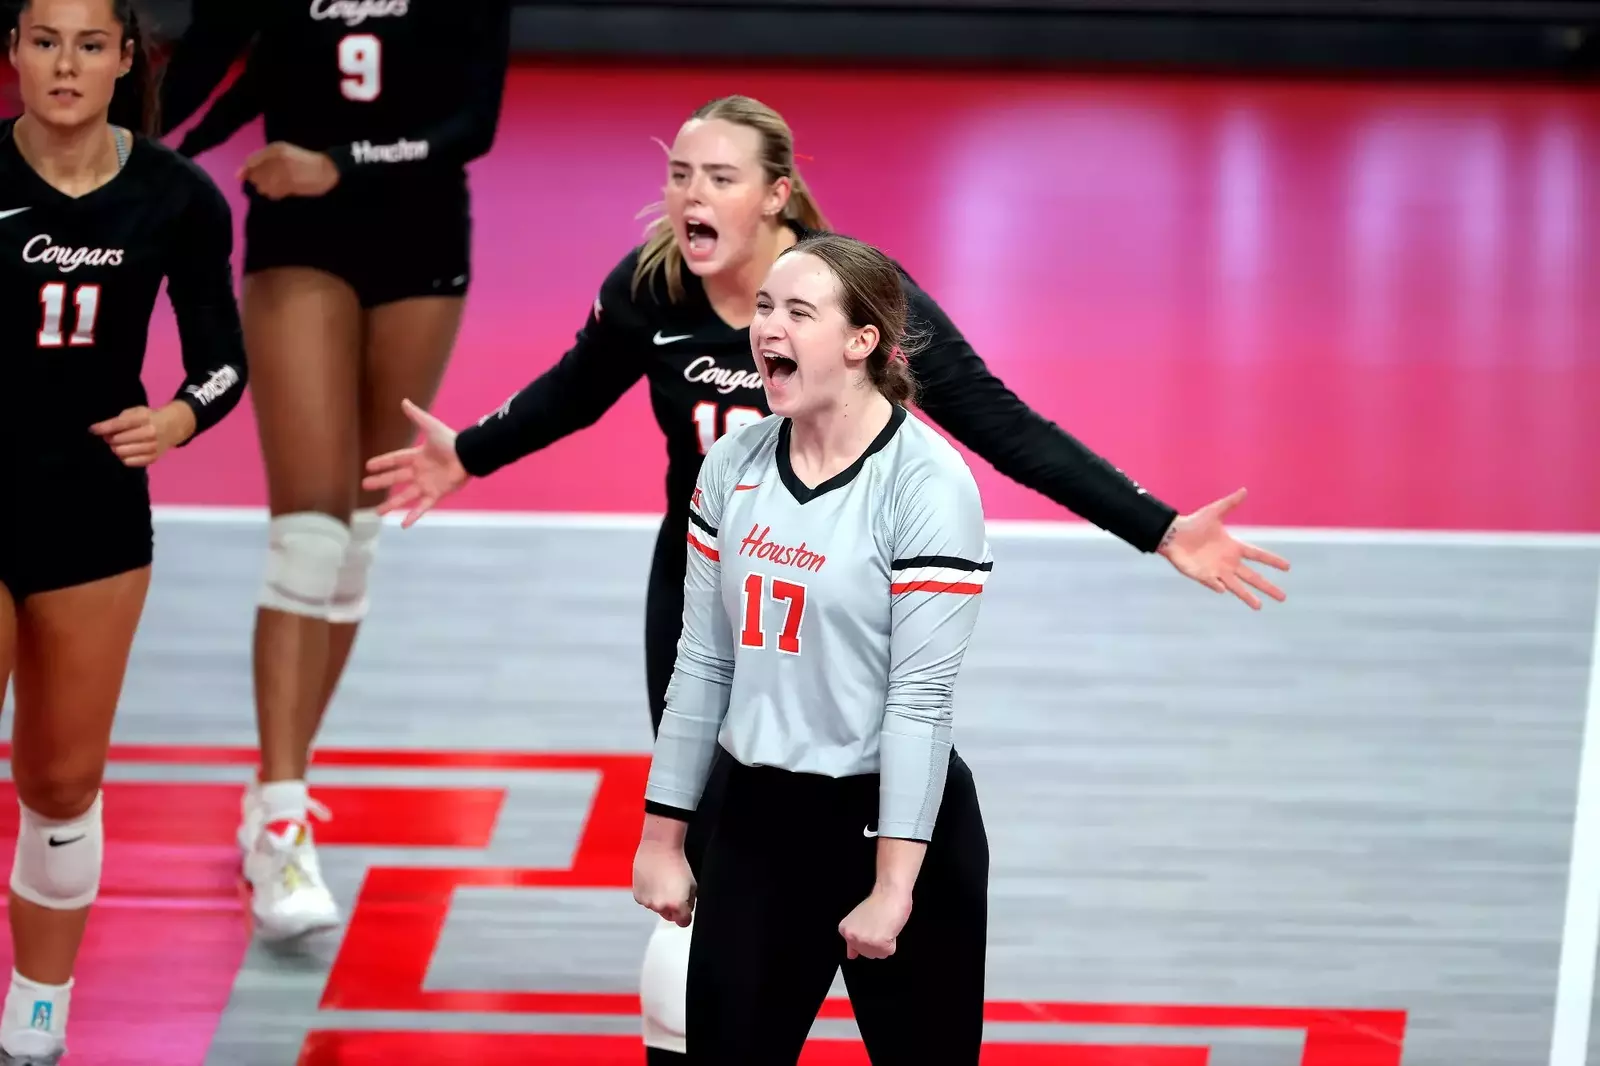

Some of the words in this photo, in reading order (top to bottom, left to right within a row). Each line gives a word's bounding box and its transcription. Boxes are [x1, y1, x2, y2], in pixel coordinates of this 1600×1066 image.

[338, 33, 382, 102] 9
[22, 233, 125, 273] Cougars
[37, 280, 101, 348] 11
[738, 523, 827, 573] Houston
[739, 571, 808, 657] 17
